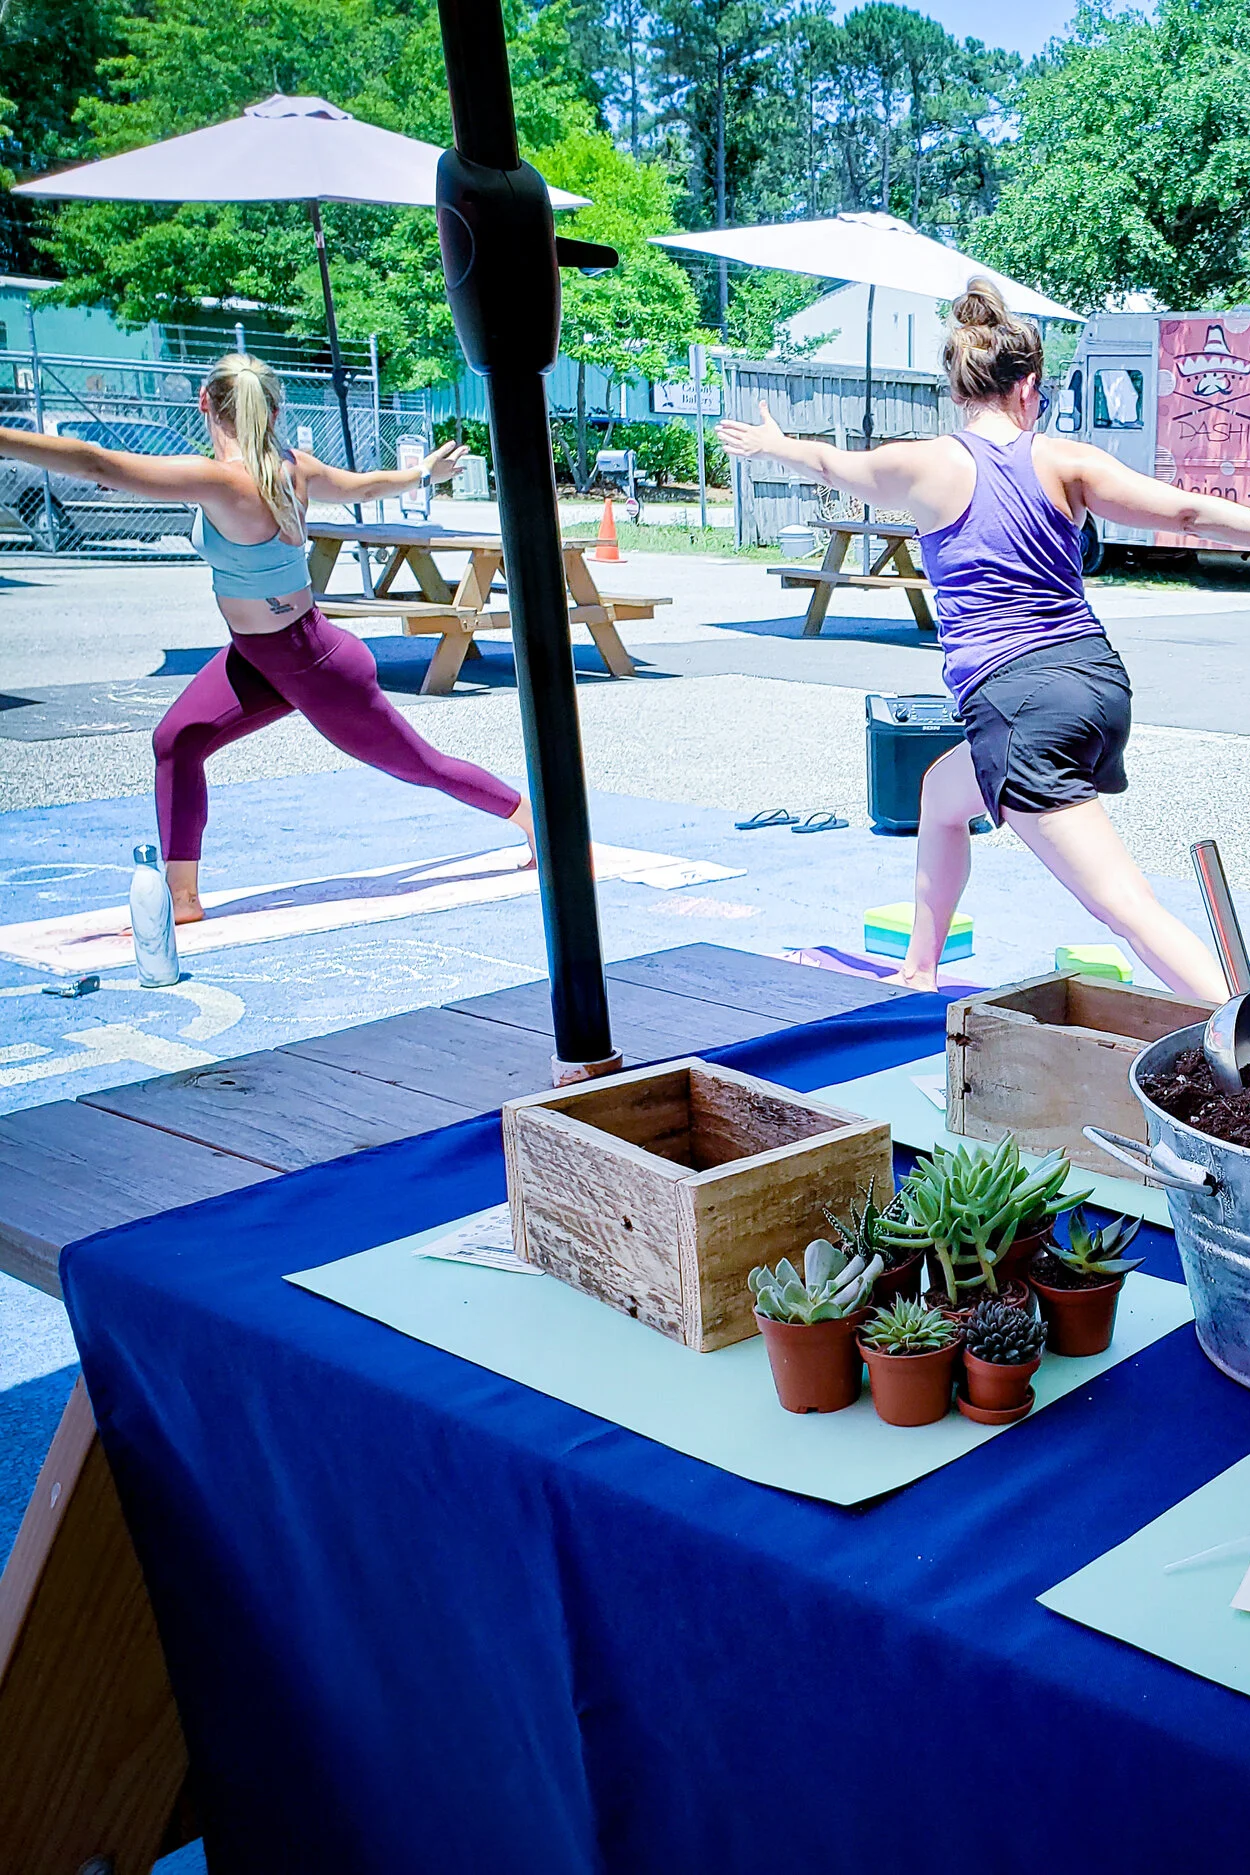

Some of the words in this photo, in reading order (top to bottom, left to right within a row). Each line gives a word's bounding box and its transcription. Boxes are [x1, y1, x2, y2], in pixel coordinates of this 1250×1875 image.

[682, 383, 712, 396] Coony
[1178, 421, 1250, 446] DASHI
[1176, 477, 1238, 502] ian
